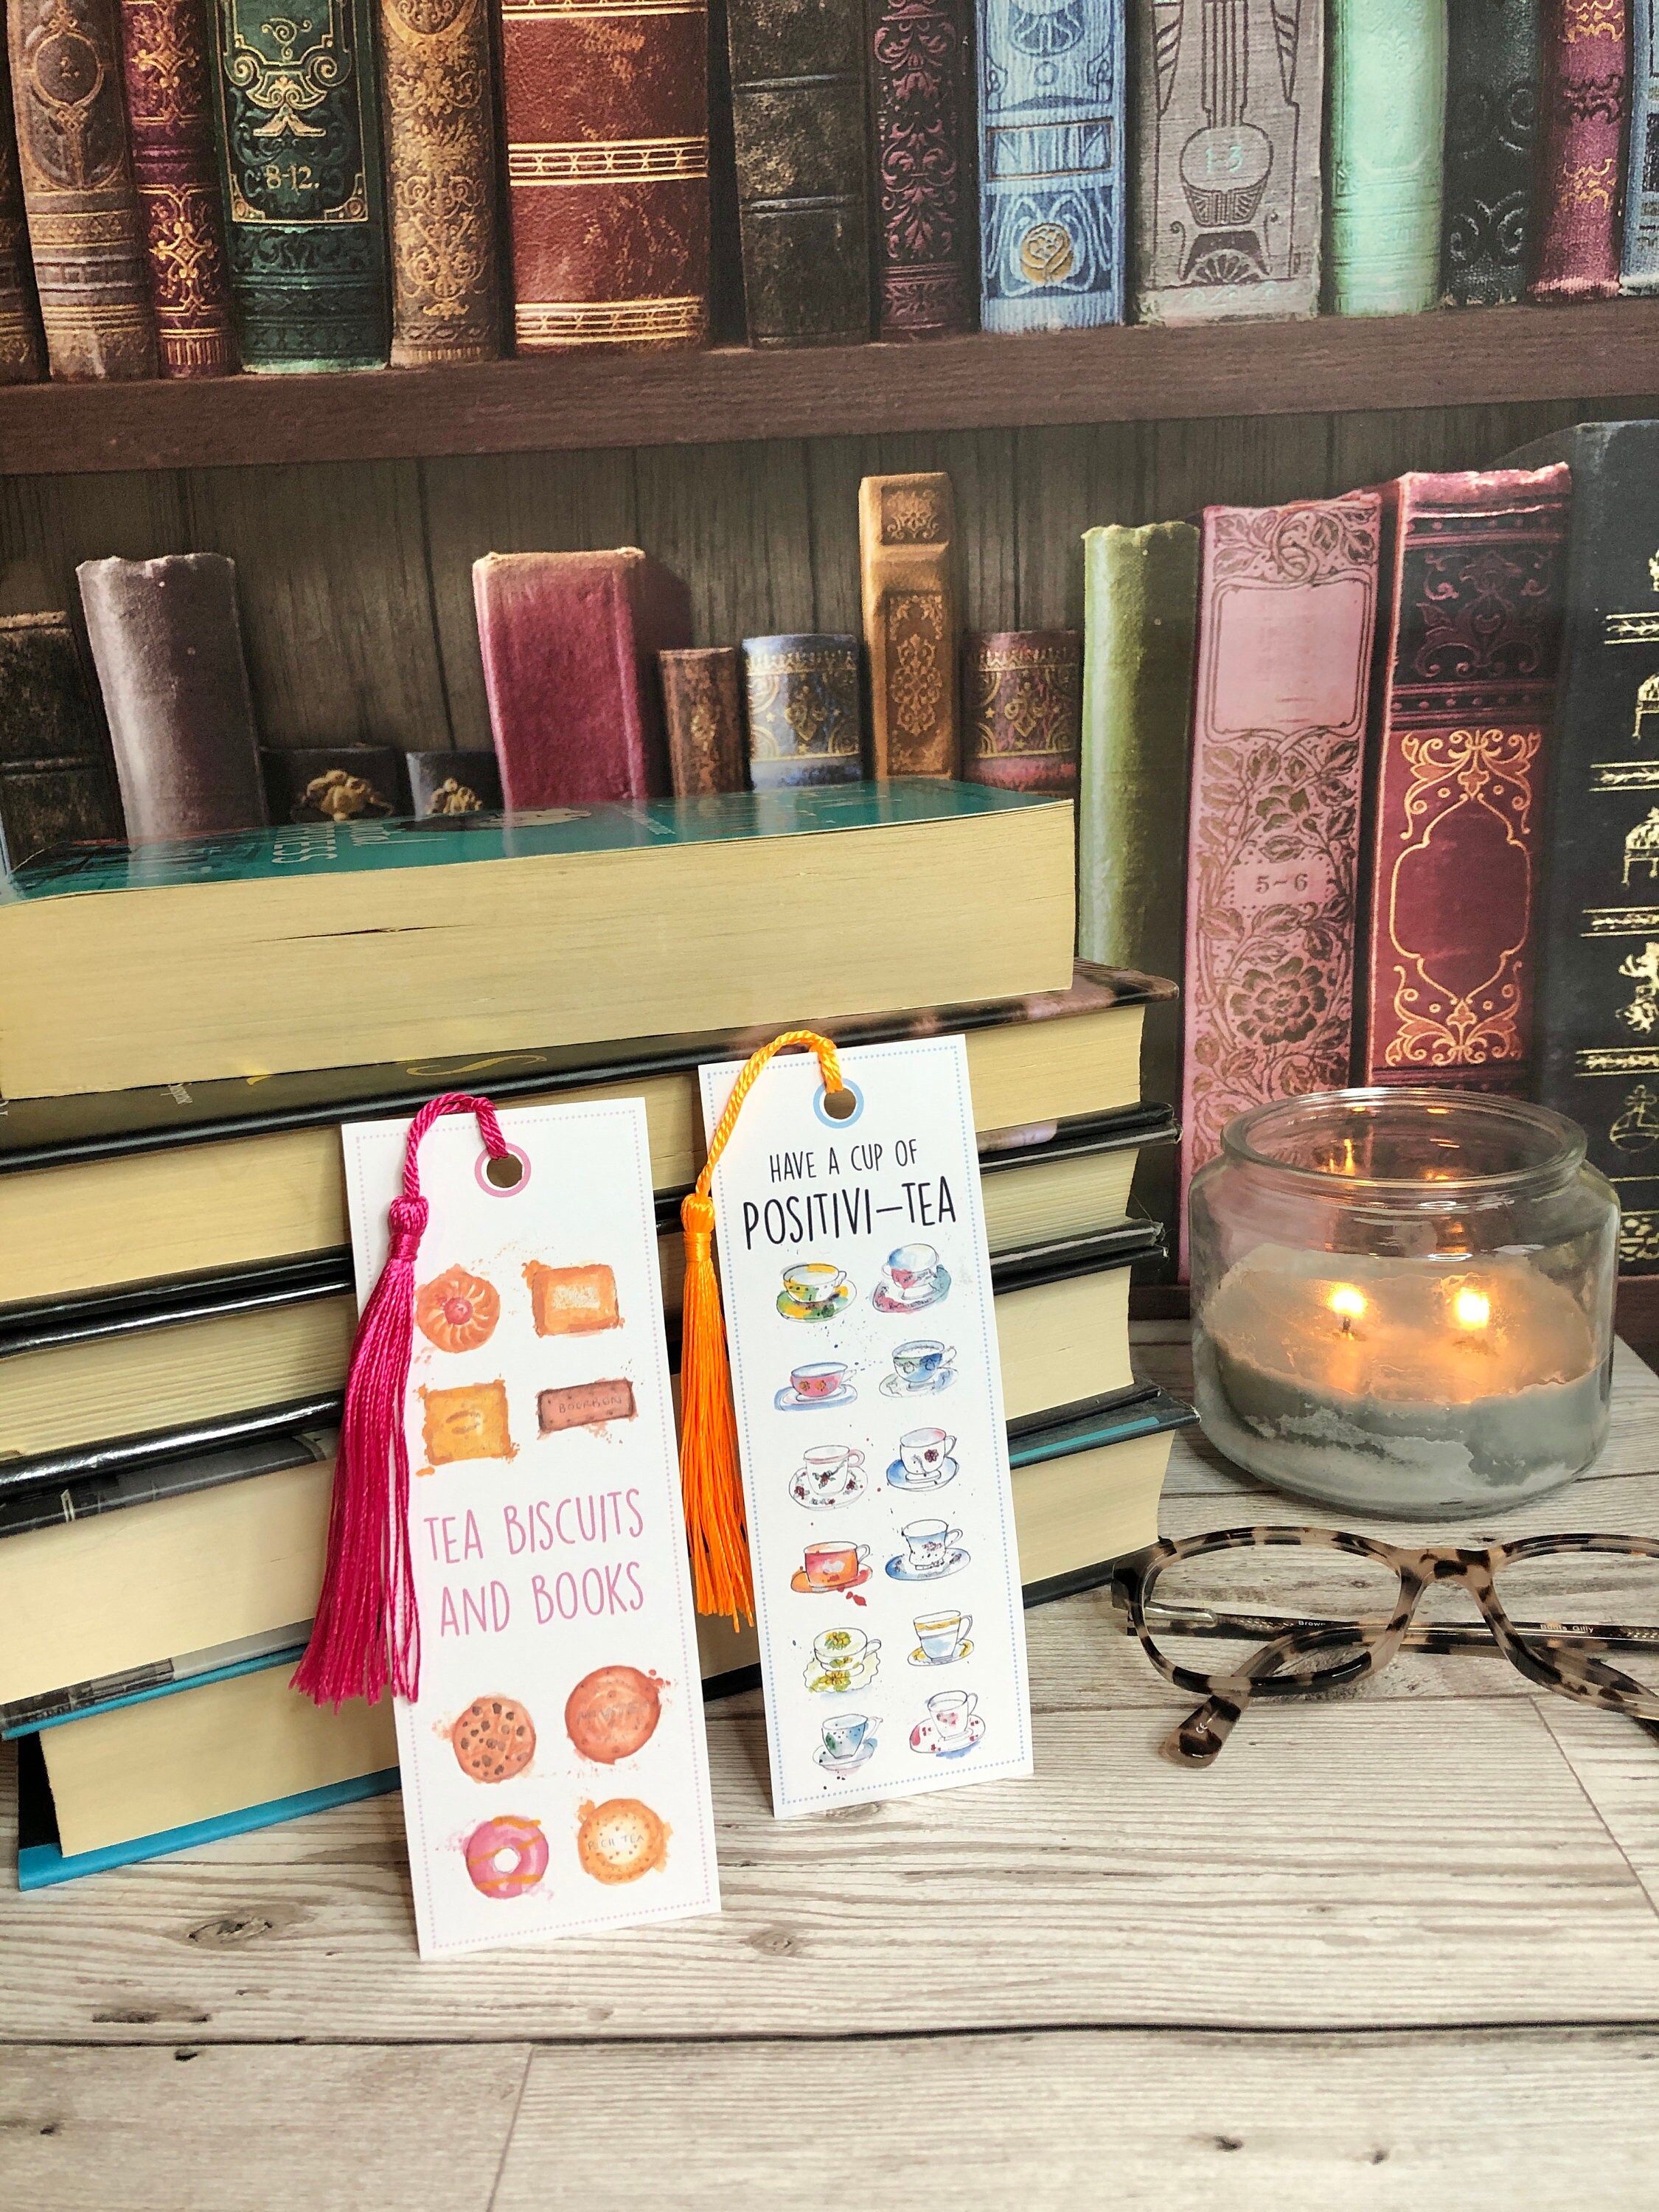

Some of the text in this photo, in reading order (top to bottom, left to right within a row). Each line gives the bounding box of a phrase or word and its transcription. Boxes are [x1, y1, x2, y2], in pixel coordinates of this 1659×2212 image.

[769, 1138, 918, 1183] HAVE A CUP OF
[558, 1396, 622, 1413] BOURBON
[422, 1487, 644, 1565] TEA BISCUITS
[440, 1560, 644, 1638] AND BOOKS
